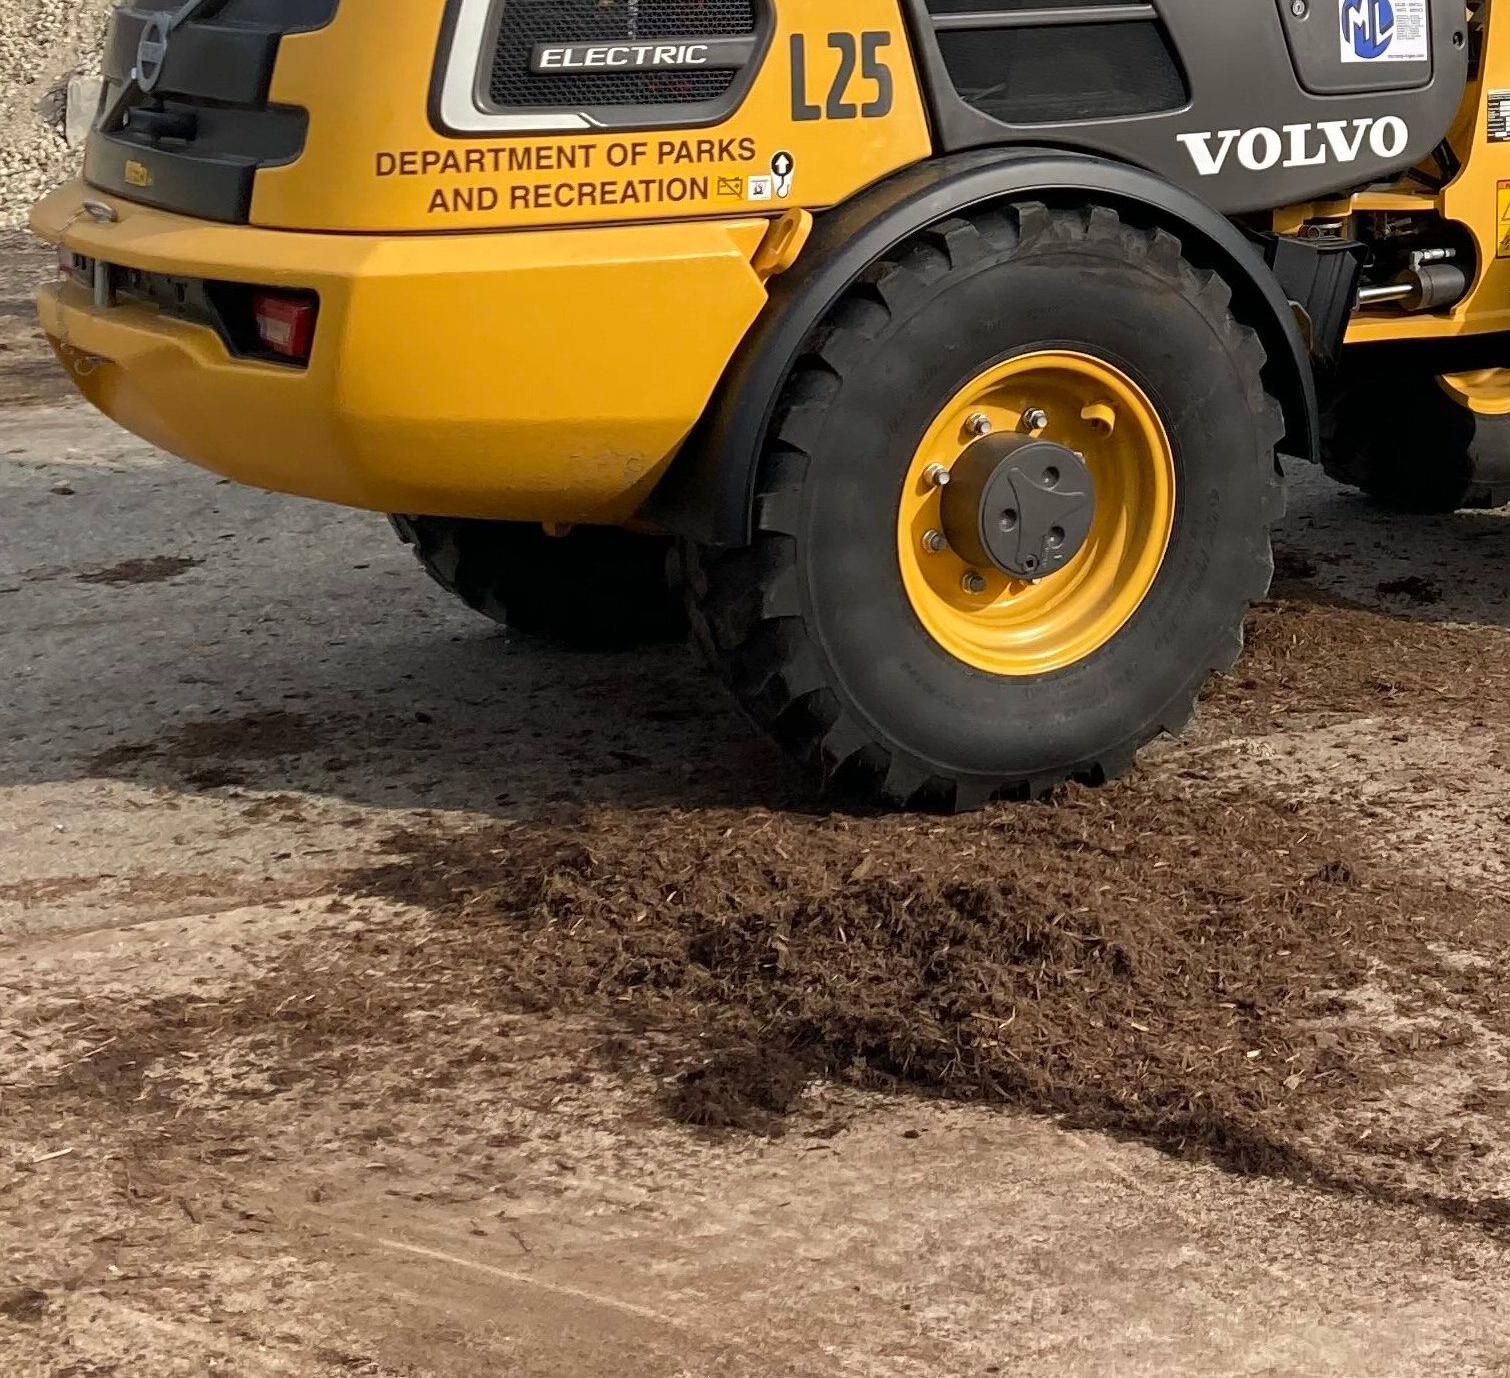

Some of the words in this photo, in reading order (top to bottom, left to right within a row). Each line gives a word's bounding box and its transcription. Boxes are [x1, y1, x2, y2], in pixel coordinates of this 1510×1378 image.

[539, 44, 708, 68] ELECTRIC
[790, 31, 893, 121] L25
[376, 144, 597, 177] DEPARTMENT
[606, 142, 648, 167] OF
[657, 137, 757, 165] PARKS
[1176, 115, 1409, 175] VOLVO
[427, 188, 499, 214] AND
[509, 176, 709, 210] RECREATION
